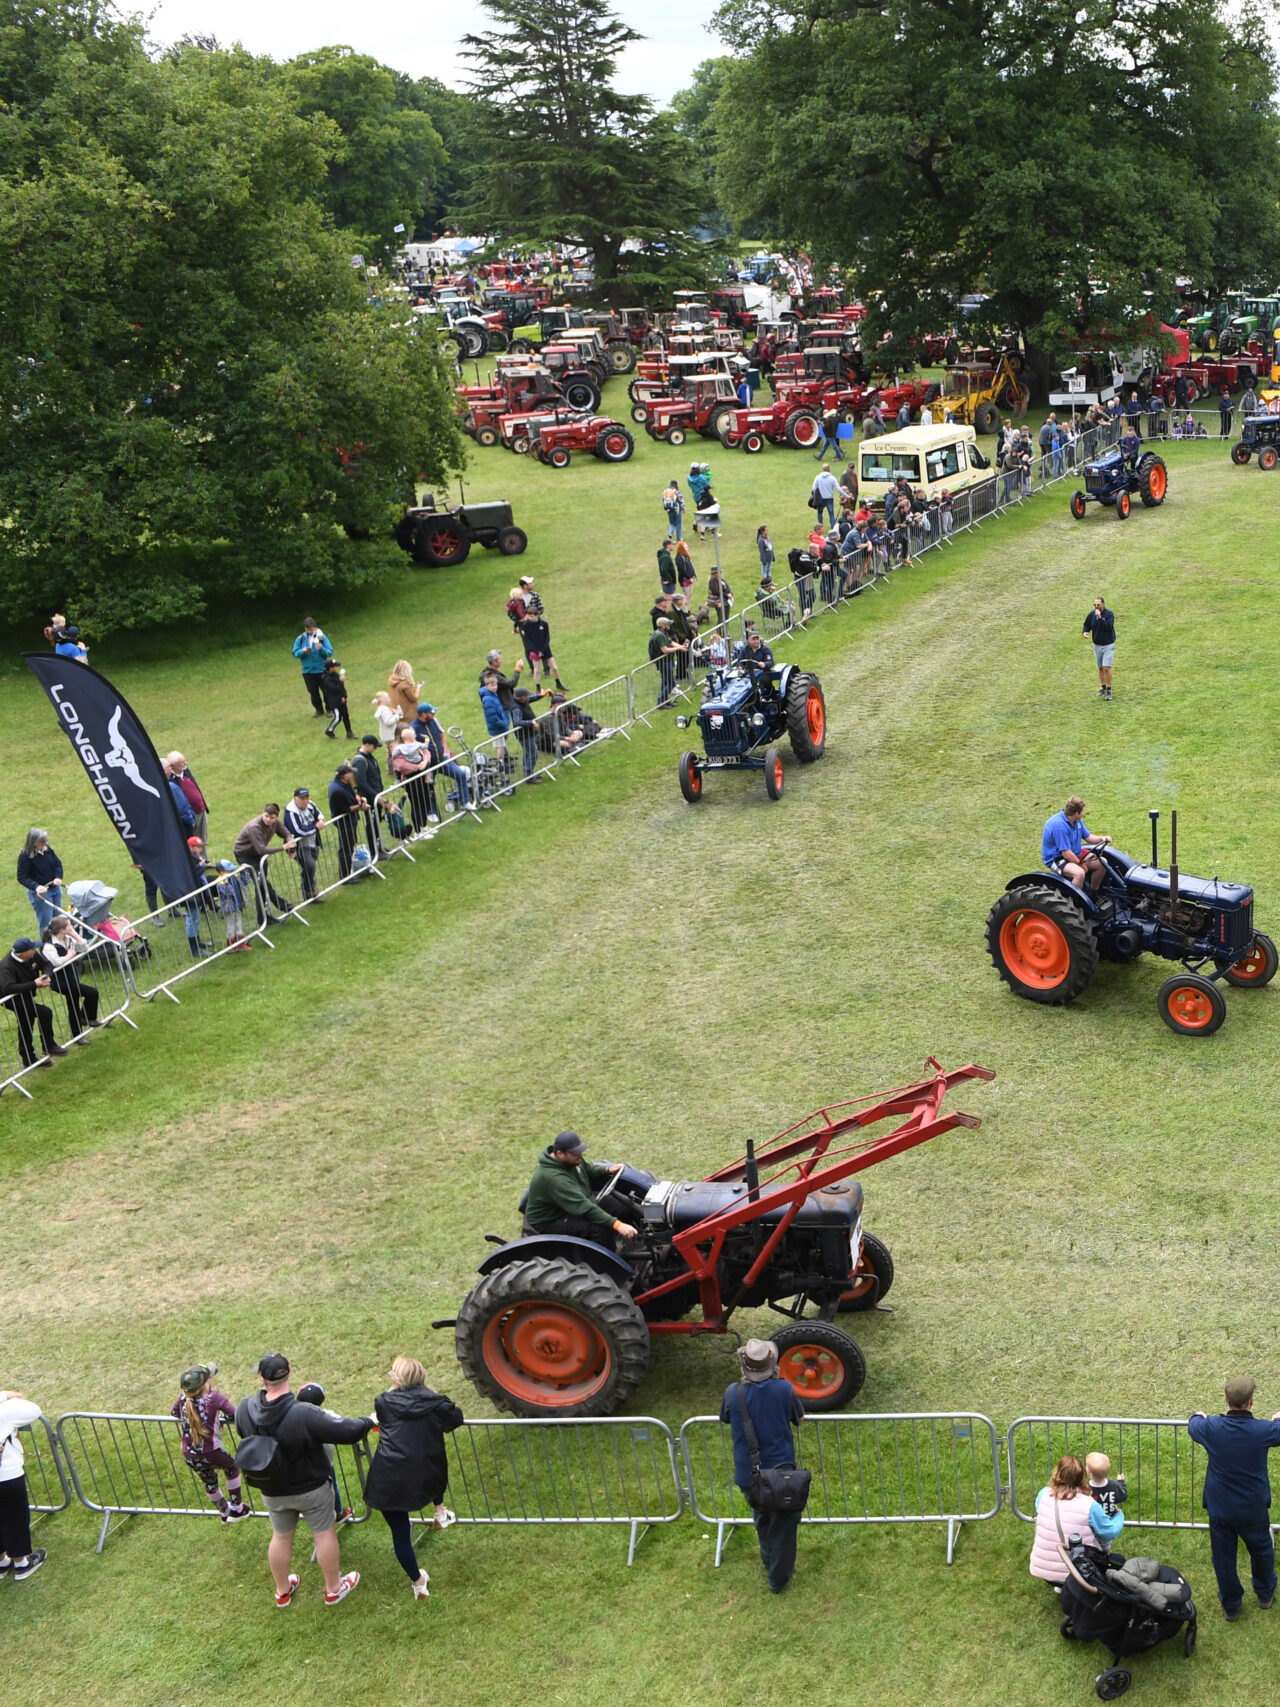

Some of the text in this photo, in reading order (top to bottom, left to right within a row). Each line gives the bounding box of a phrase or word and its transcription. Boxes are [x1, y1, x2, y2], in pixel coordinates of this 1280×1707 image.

[874, 443, 907, 452] Ice Cream
[50, 684, 137, 841] LONGHORN
